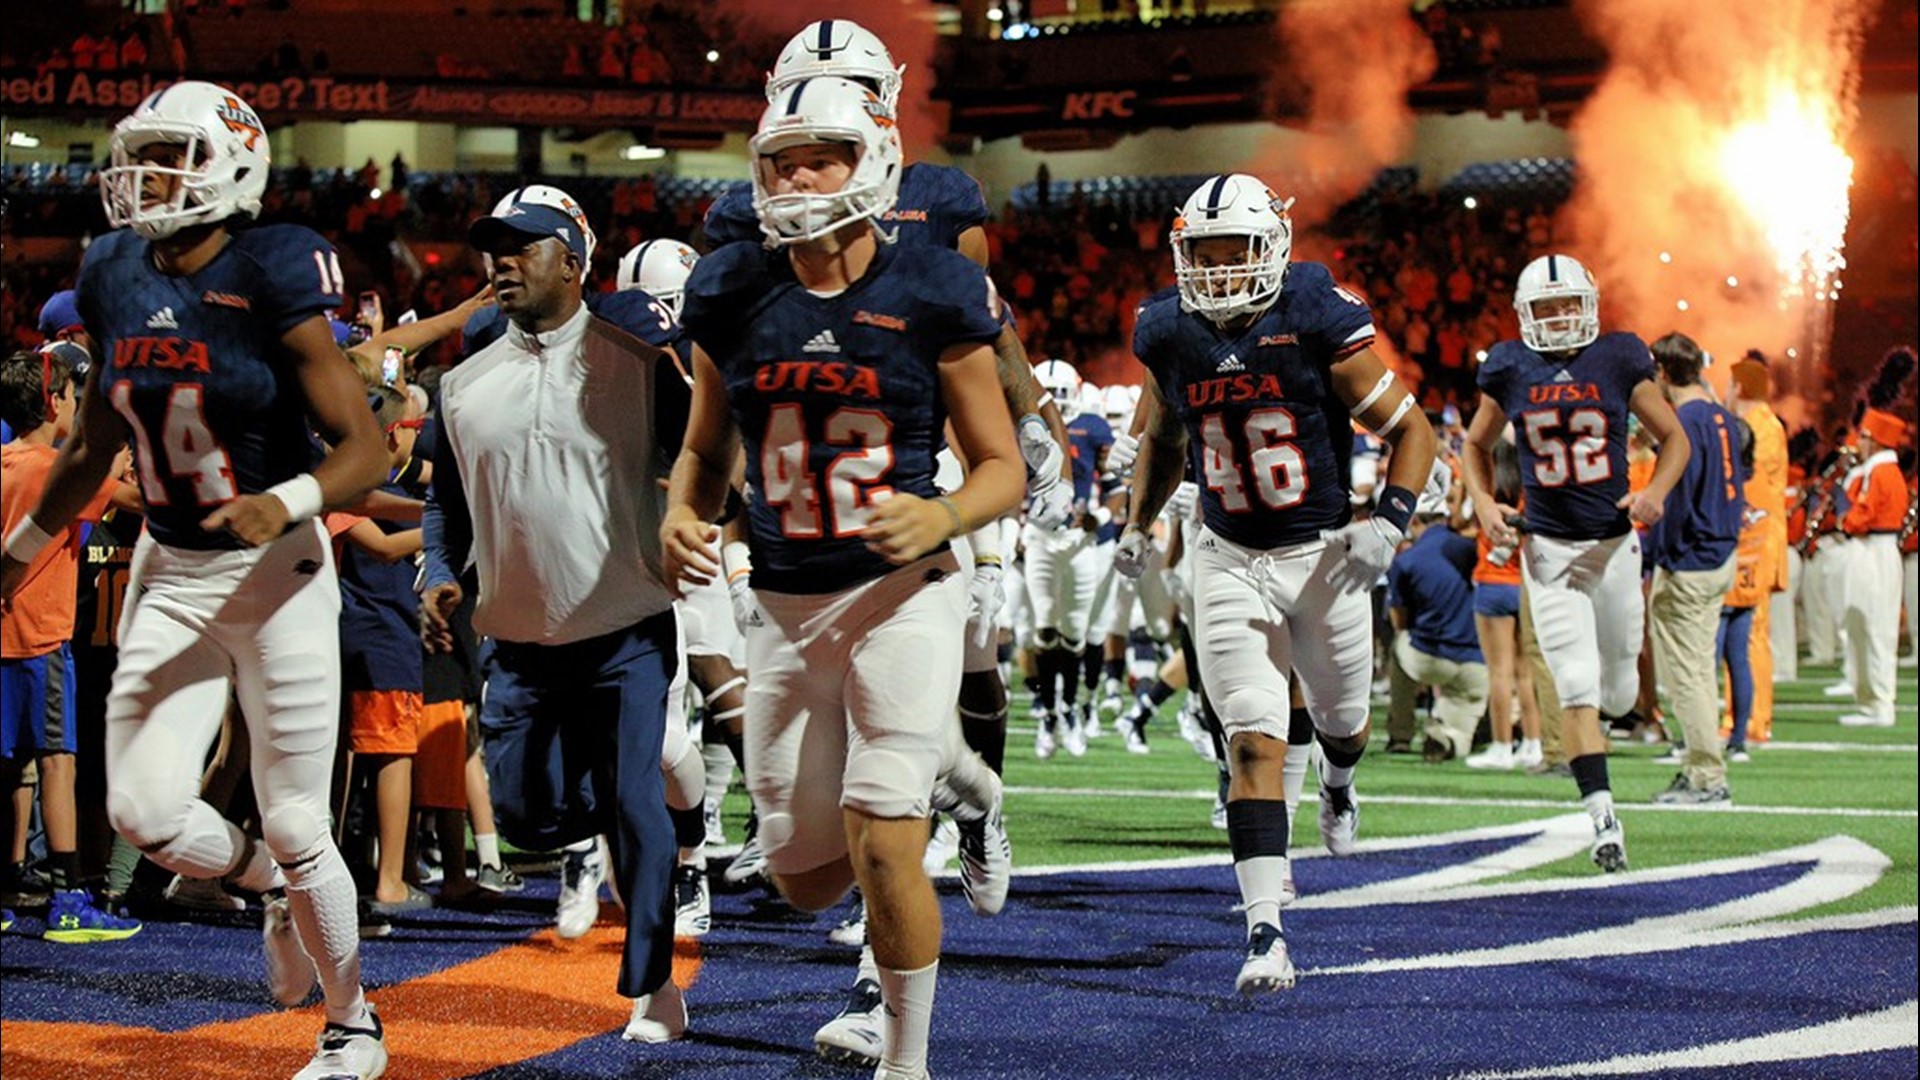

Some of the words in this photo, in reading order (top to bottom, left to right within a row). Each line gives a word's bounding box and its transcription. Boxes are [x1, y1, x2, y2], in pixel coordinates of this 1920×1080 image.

[309, 77, 389, 111] Text
[1062, 90, 1136, 120] KFC
[113, 336, 211, 374] UTSA
[754, 361, 882, 398] UTSA
[1186, 374, 1284, 408] UTSA
[1529, 383, 1601, 405] UTSA
[109, 379, 239, 505] 14
[1200, 407, 1310, 514] 46
[1521, 406, 1612, 487] 52
[761, 402, 896, 538] 42
